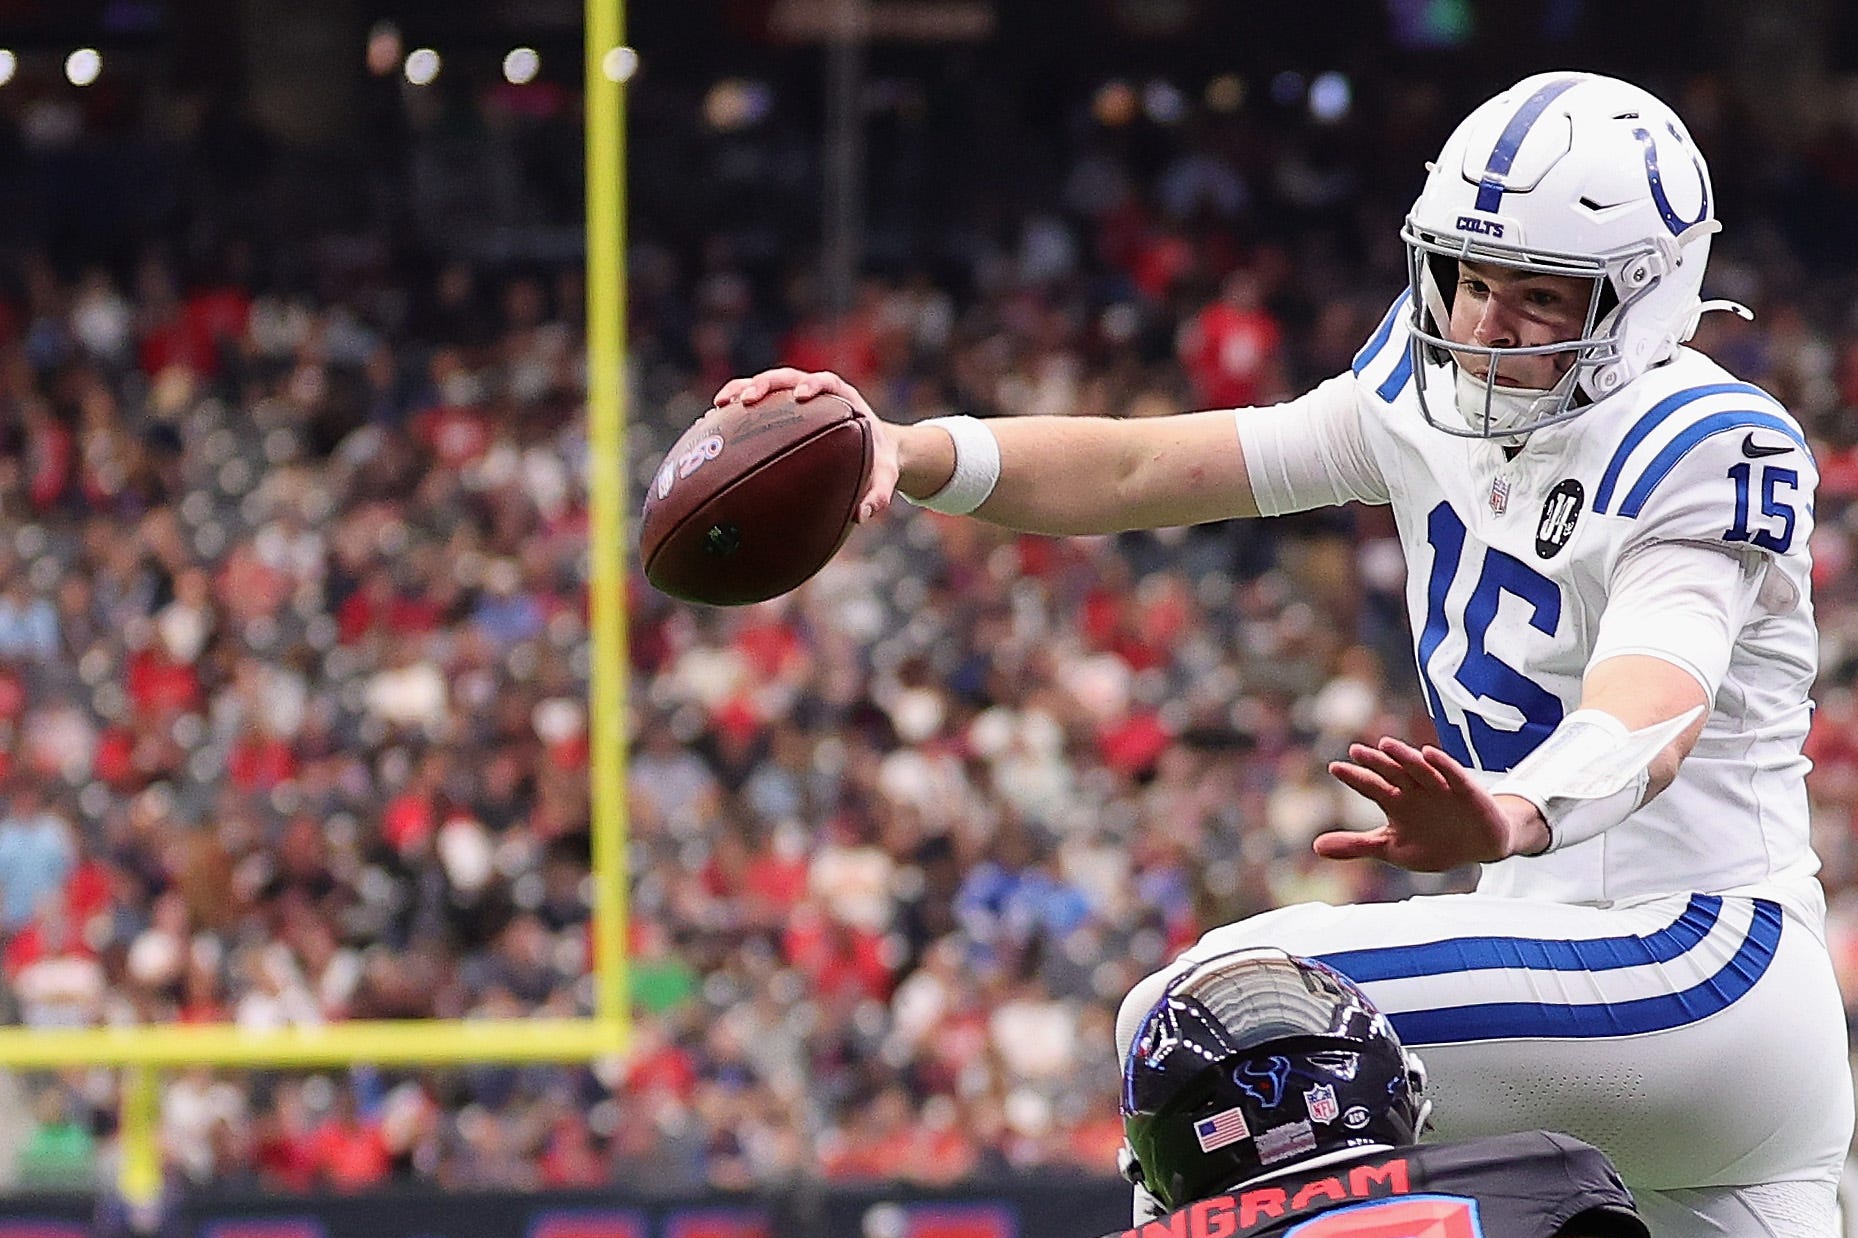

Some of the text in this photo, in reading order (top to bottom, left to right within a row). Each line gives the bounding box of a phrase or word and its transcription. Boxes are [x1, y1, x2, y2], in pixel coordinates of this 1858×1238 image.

[1456, 216, 1505, 239] COLTS
[1721, 461, 1799, 555] 15
[1418, 500, 1565, 774] 15
[1311, 1099, 1336, 1119] NFL
